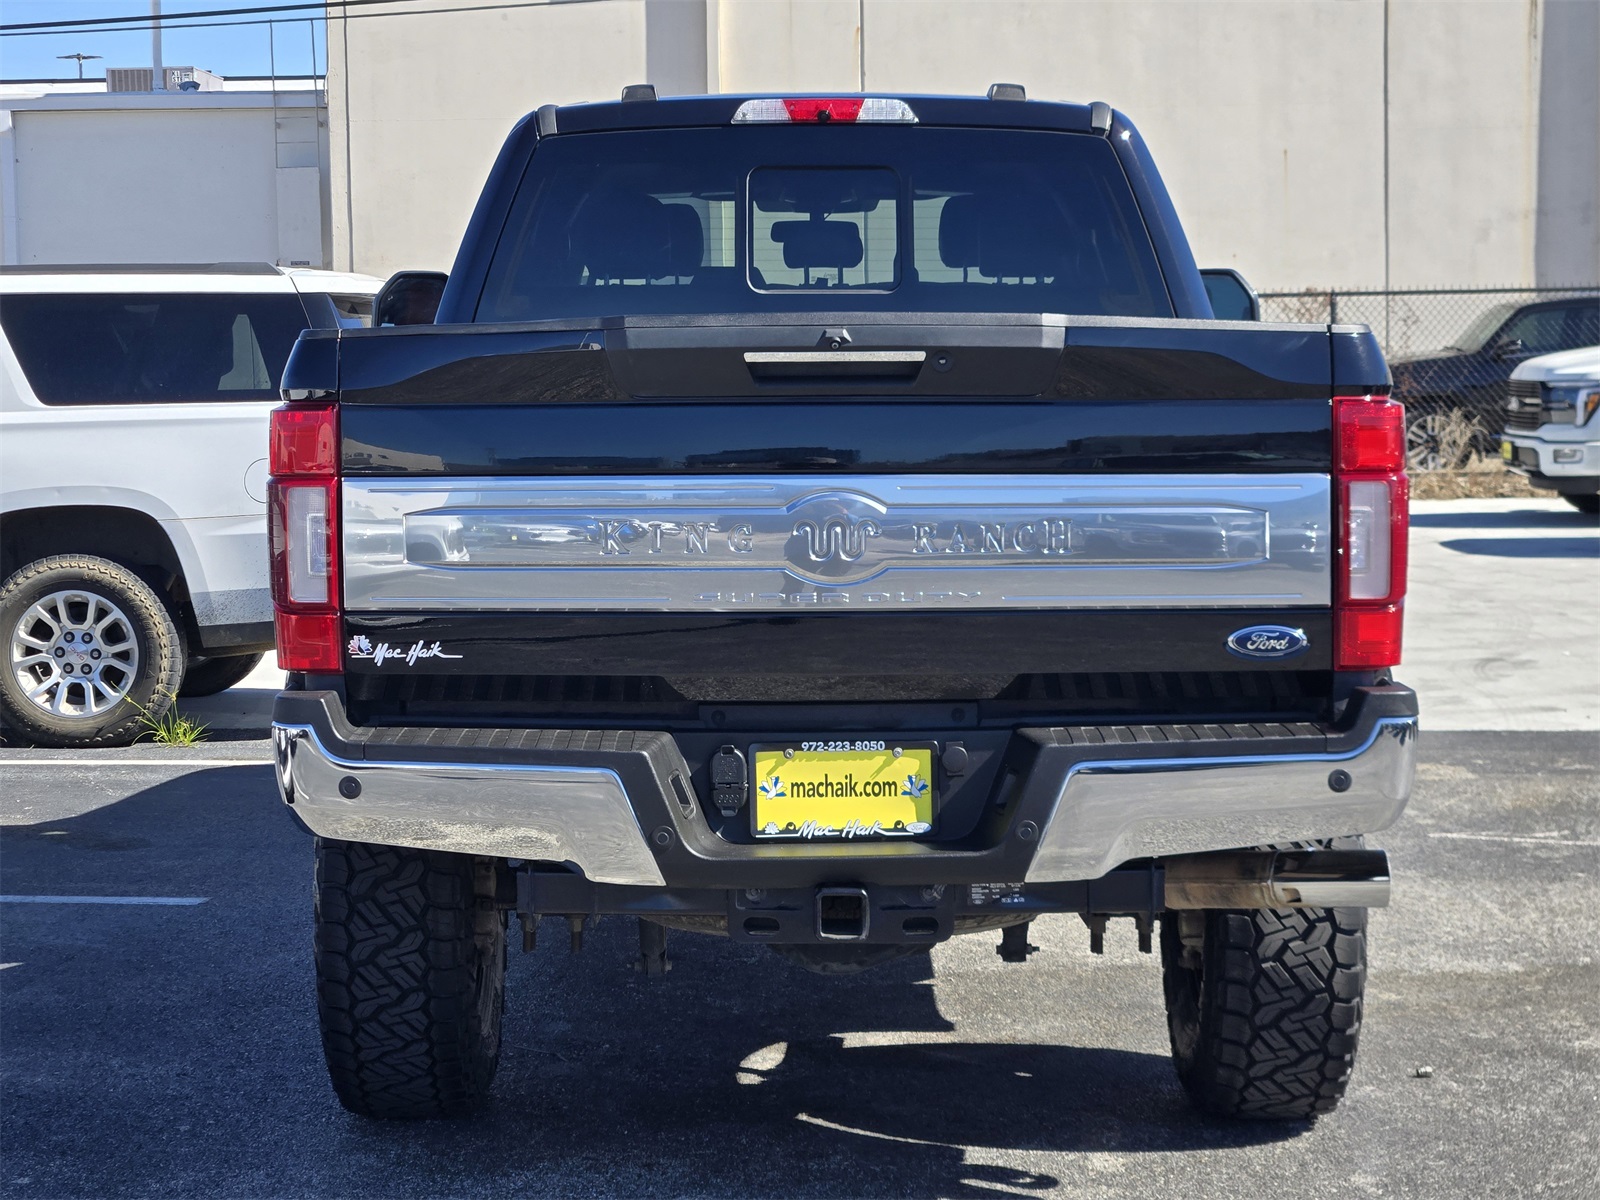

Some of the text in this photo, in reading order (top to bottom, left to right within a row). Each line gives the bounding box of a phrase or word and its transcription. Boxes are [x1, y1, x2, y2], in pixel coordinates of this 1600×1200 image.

[598, 518, 1074, 556] KING RANCH
[1246, 631, 1290, 650] Ford
[372, 640, 458, 667] Mac Haik
[801, 741, 886, 752] 972-223-8050
[790, 773, 898, 799] machaik.com
[797, 819, 840, 840] Mac
[840, 818, 891, 839] Haik
